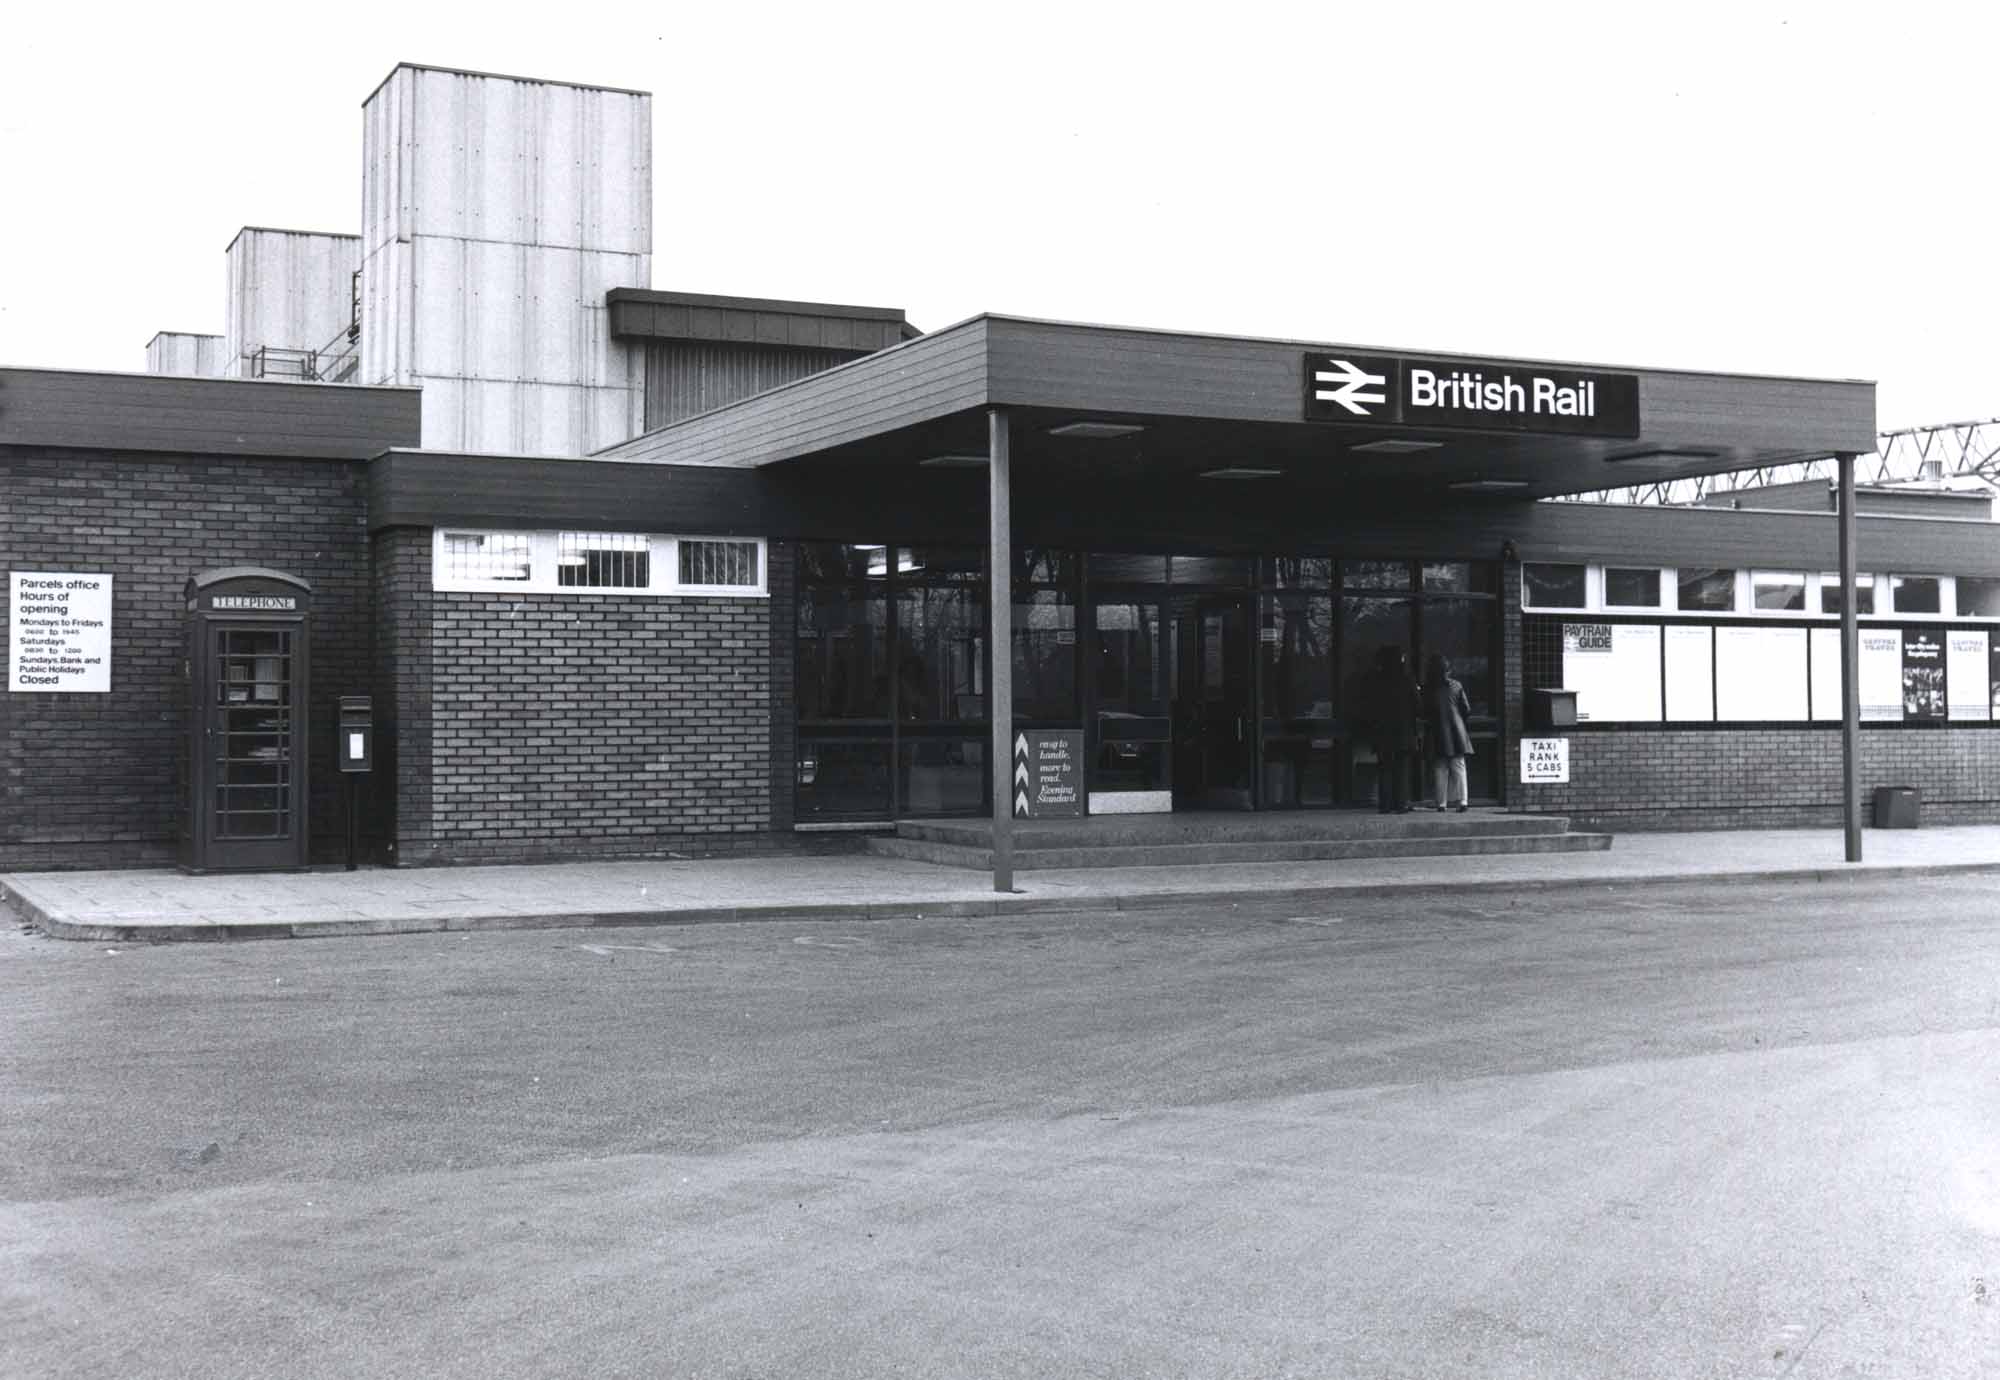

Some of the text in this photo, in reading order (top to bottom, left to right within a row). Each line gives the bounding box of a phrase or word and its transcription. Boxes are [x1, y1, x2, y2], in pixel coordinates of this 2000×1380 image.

[1411, 369, 1595, 417] British Rail
[20, 578, 100, 590] Parcels office
[20, 592, 70, 601] Hours of
[216, 597, 293, 608] TELEPHONE
[20, 604, 68, 616] opening
[19, 618, 104, 628] Mondays to Fridays
[1564, 625, 1612, 636] PAYTRAIN
[20, 637, 66, 646] Saturdays
[1579, 637, 1612, 648] GUIDE
[49, 647, 58, 655] to
[19, 665, 85, 675] Public Holidays
[19, 675, 59, 684] Closed
[1059, 740, 1068, 748] to
[1532, 742, 1557, 751] TAXI
[1529, 752, 1560, 761] RANK
[1062, 763, 1071, 772] to
[1527, 762, 1562, 771] 5 CABS
[1041, 785, 1074, 794] Evening
[1038, 793, 1077, 803] Standard
